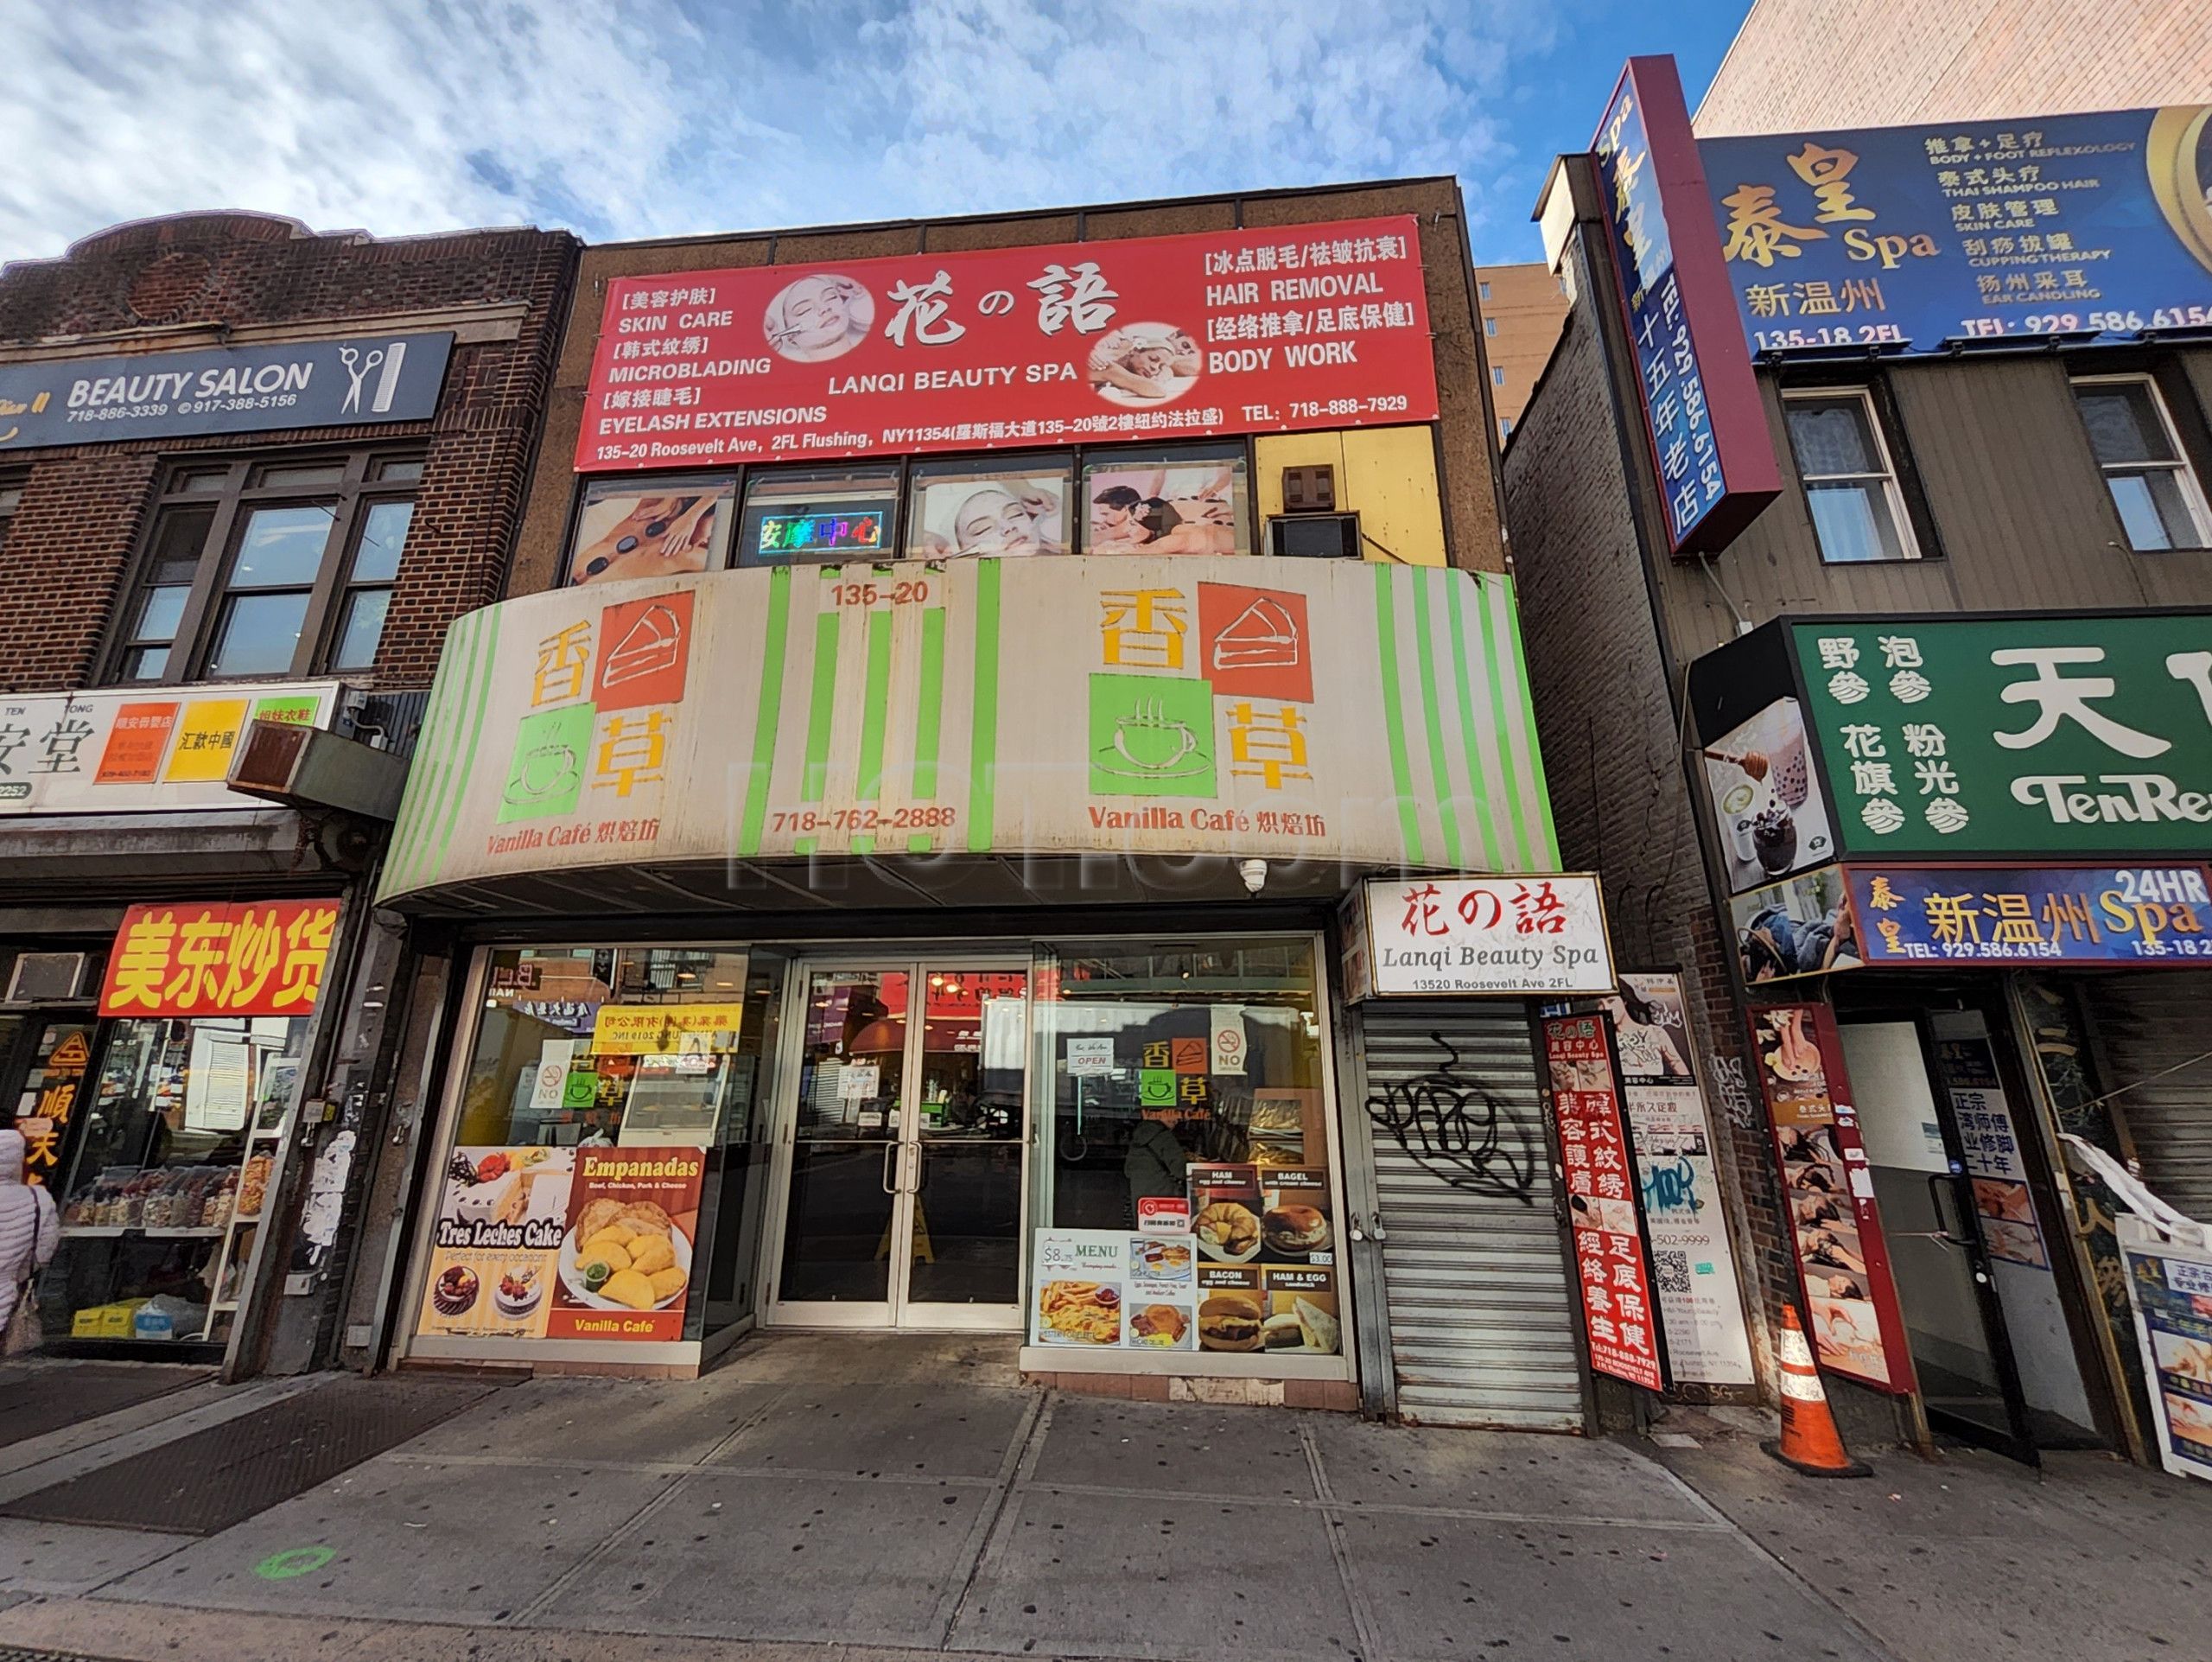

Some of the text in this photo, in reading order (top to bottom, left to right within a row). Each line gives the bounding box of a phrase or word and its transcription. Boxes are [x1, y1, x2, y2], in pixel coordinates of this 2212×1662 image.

[1930, 154, 1969, 165] BODY
[1986, 150, 2024, 162] FOOT
[1942, 179, 2101, 198] THAI SHAMPOO HAIR
[1951, 198, 2059, 221] 皮肤管理
[1955, 219, 2036, 232] SKIN CARE
[1843, 227, 1940, 271] Spa
[1968, 249, 2111, 268] CUPPING THERAPY
[1206, 273, 1383, 307] HAIR REMOVAL
[1976, 269, 2088, 293] 扬州采耳
[885, 263, 1120, 347] 花の語
[1661, 272, 1681, 331] TEL:
[1745, 277, 1887, 318] 新温州
[1982, 294, 2013, 304] EAR
[619, 310, 734, 333] SKIN CARE
[608, 358, 772, 384] MICROBLADING
[1209, 342, 1357, 374] BODY WORK
[67, 371, 194, 409] BEAUTY
[194, 362, 314, 398] SALON
[828, 363, 1077, 395] LANQI BEAUTY SPA
[67, 404, 168, 423] 718-886-3339
[599, 406, 828, 436] EYELASH EXTENSIONS
[1242, 394, 1408, 423] TEL: 718-888-7929
[1638, 311, 1699, 535] 十五年老店
[596, 442, 647, 461] 135-20
[651, 438, 725, 457] Roosevelt
[772, 434, 800, 450] 2FL
[803, 430, 874, 451] Flushing,
[831, 581, 930, 606] 135-20
[1100, 588, 1188, 670] 香
[531, 620, 592, 708] 香
[5, 706, 27, 716] TEN
[591, 711, 672, 798] 草
[1225, 702, 1313, 790] 草
[772, 806, 957, 833] 718-762-2888
[1088, 806, 1325, 837] Vanilla Café 烘焙坊
[486, 818, 661, 856] Vanilla Café 烘焙坊
[2115, 869, 2210, 903] 24HR
[1401, 881, 1567, 937] 花の語
[1923, 892, 2101, 945] 新温州
[2100, 889, 2204, 946] Spa
[108, 907, 337, 1009] 美东炒货
[1382, 946, 1599, 971] Lanqi Beauty Spa
[1904, 940, 2063, 958] TEL: 929.586.6154
[2132, 939, 2198, 957] 135-18
[1413, 977, 1573, 990] 13520 Roosevelt Ave 2FL
[1217, 1054, 1241, 1066] NO
[537, 1089, 558, 1099] NO
[1142, 1109, 1182, 1121] Vanilla
[582, 1156, 699, 1181] Empanadas
[1278, 1172, 1308, 1181] BAGEL
[440, 1220, 562, 1246] Tres Leches Cake
[1075, 1245, 1119, 1258] MENU
[1209, 1270, 1243, 1279] BACON
[1273, 1272, 1294, 1281] HAM
[1306, 1273, 1326, 1282] EGG
[575, 1319, 620, 1332] Vanilla
